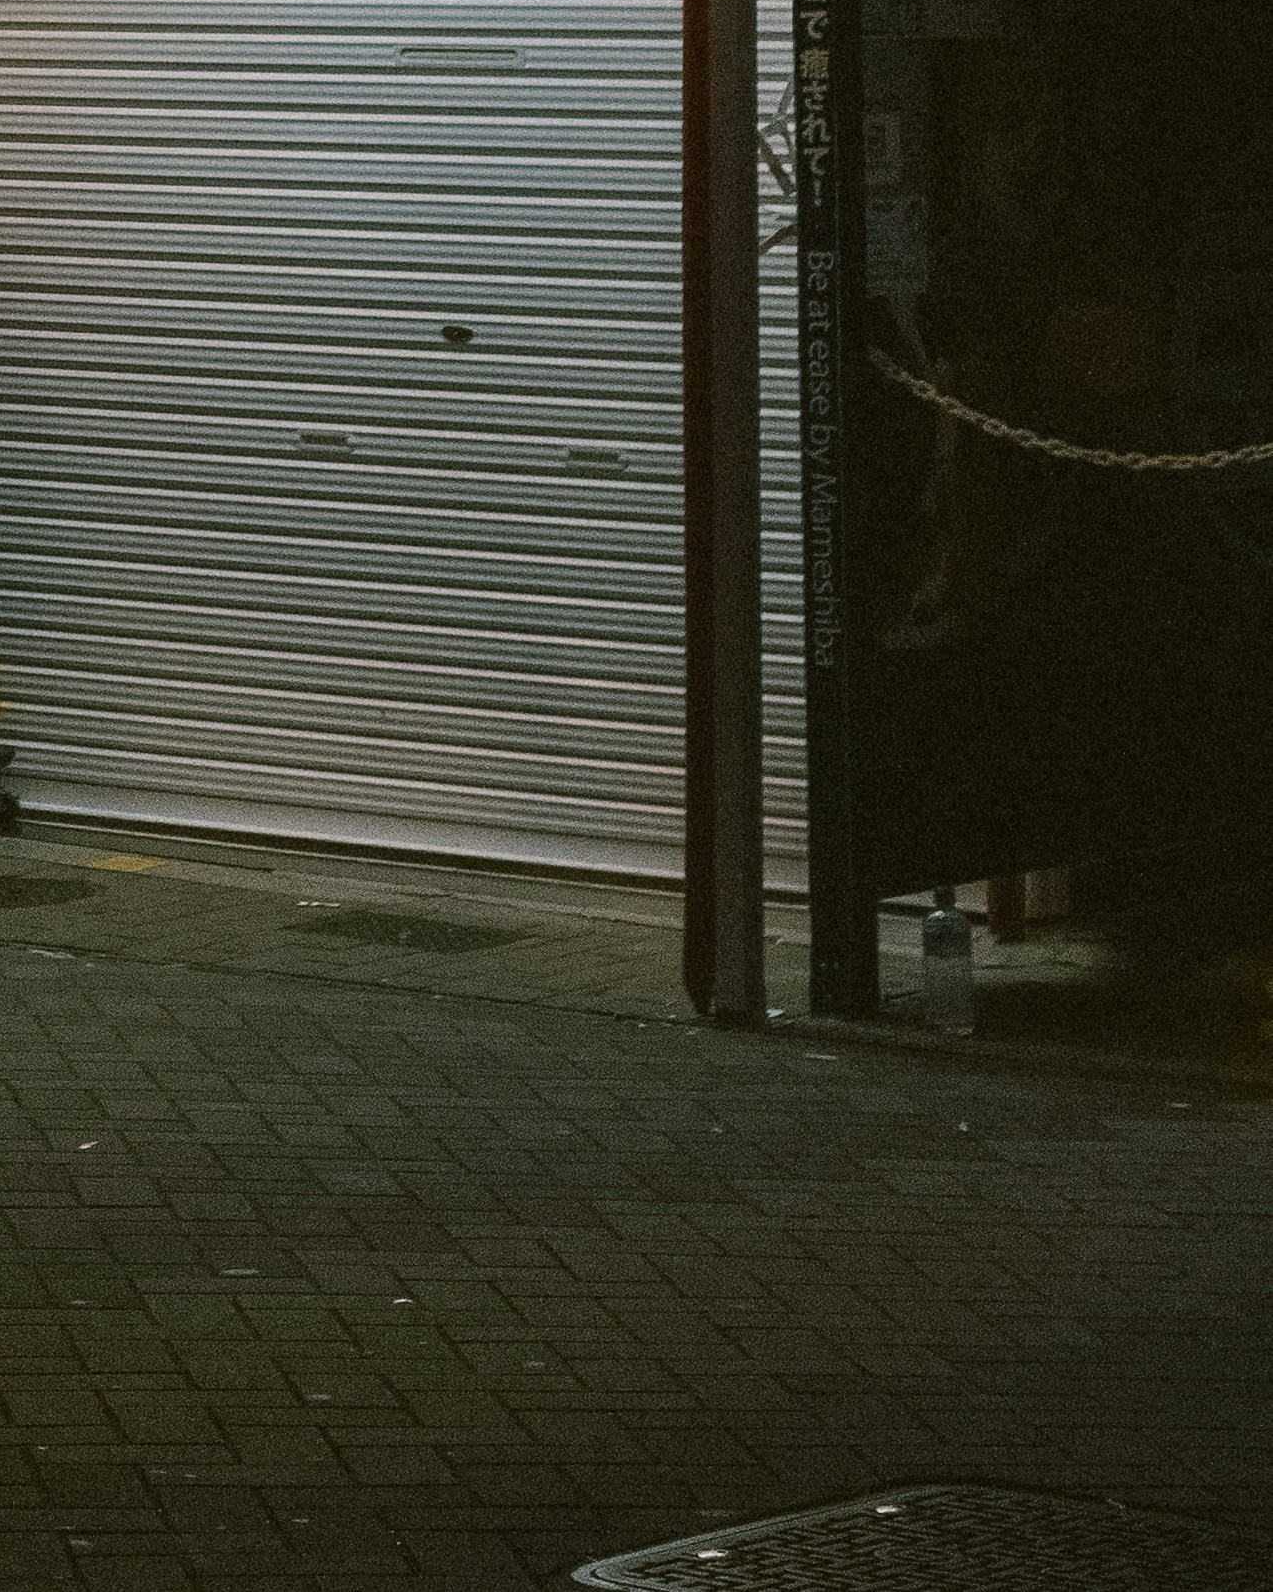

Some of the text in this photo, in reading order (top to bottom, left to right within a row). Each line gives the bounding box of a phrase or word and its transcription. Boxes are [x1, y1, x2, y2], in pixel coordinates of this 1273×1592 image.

[805, 250, 841, 669] Be at ease by Mameshiba
